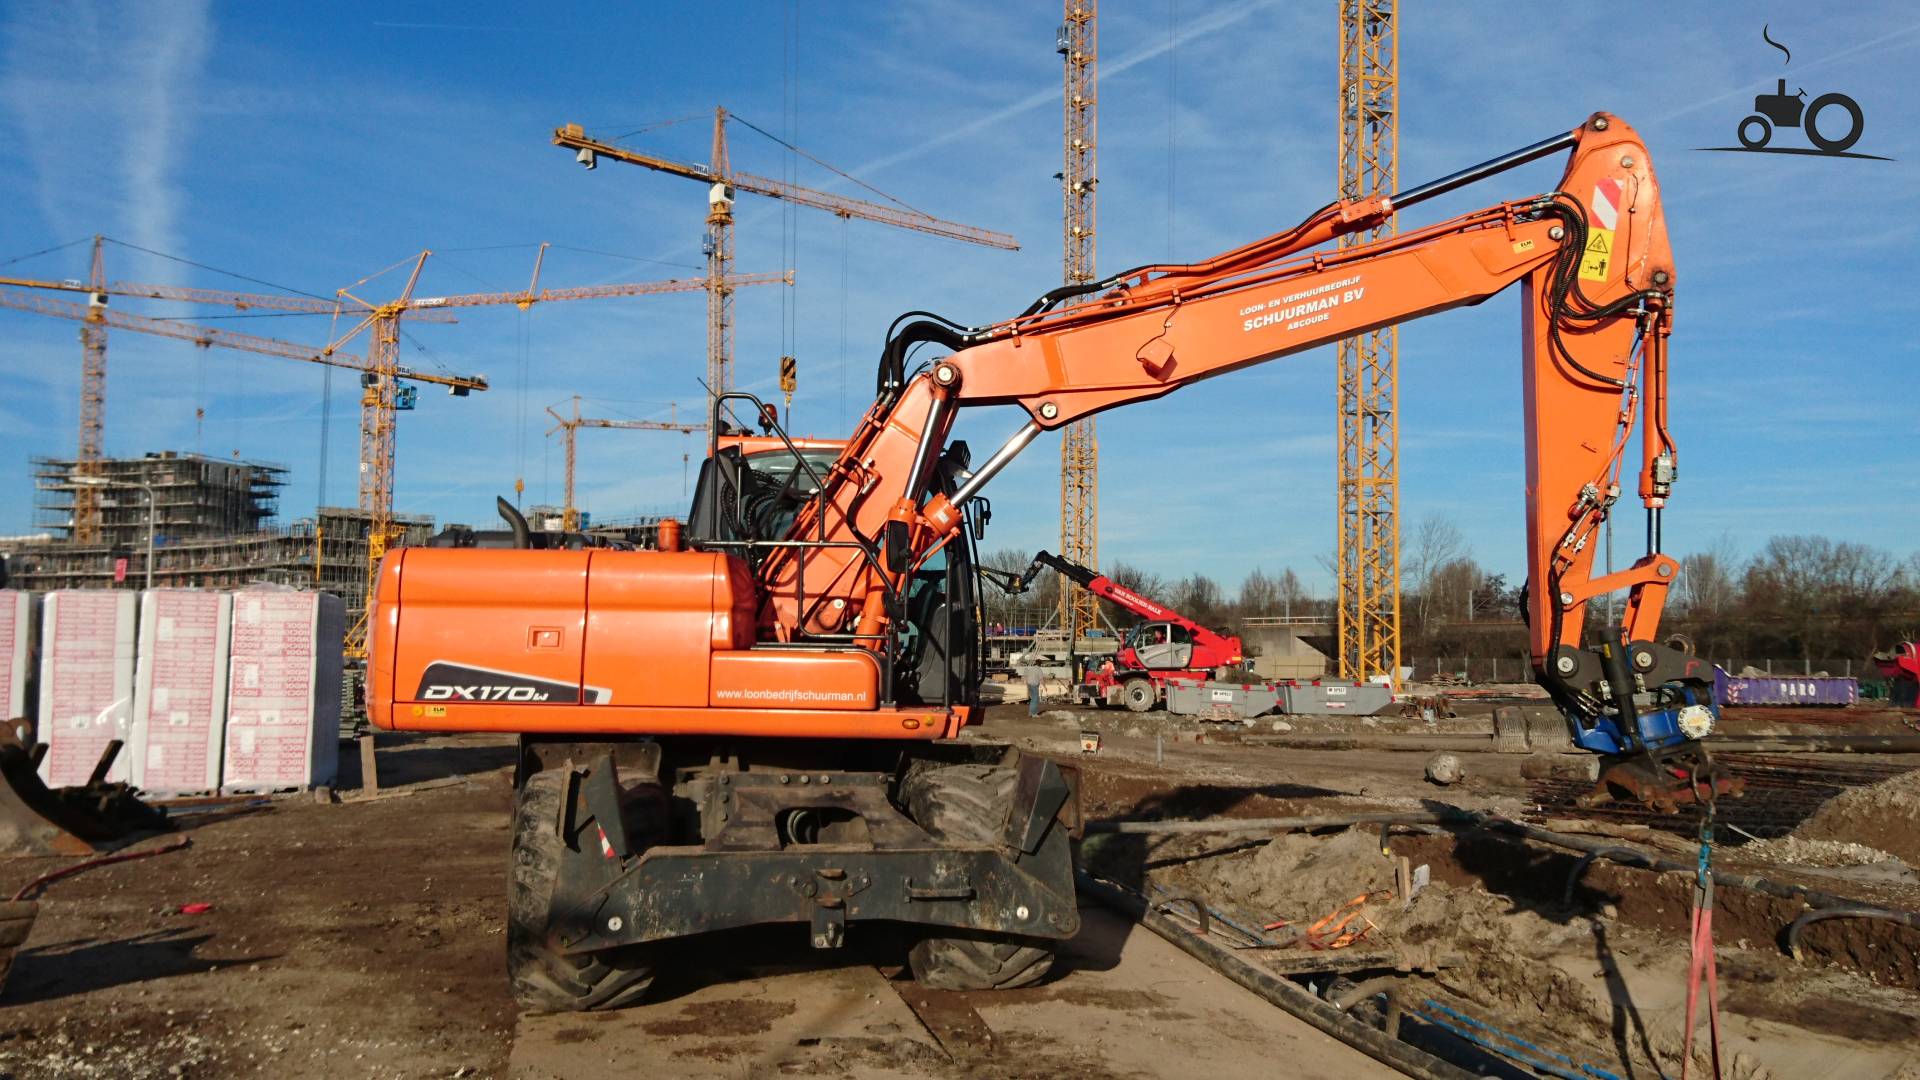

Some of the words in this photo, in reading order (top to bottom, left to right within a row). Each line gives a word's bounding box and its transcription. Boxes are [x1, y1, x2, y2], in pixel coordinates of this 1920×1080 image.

[1349, 85, 1356, 103] 6
[1240, 303, 1266, 316] LOON-
[1268, 299, 1281, 308] EN
[1283, 276, 1361, 304] VERHUURBEDRIJF
[1243, 295, 1339, 332] SCHUURMAN
[1343, 288, 1365, 303] BV
[1287, 312, 1330, 331] ABCOUDE
[716, 689, 867, 702] www.loonbedrijfschuurman.nl
[1780, 683, 1816, 697] PARO
